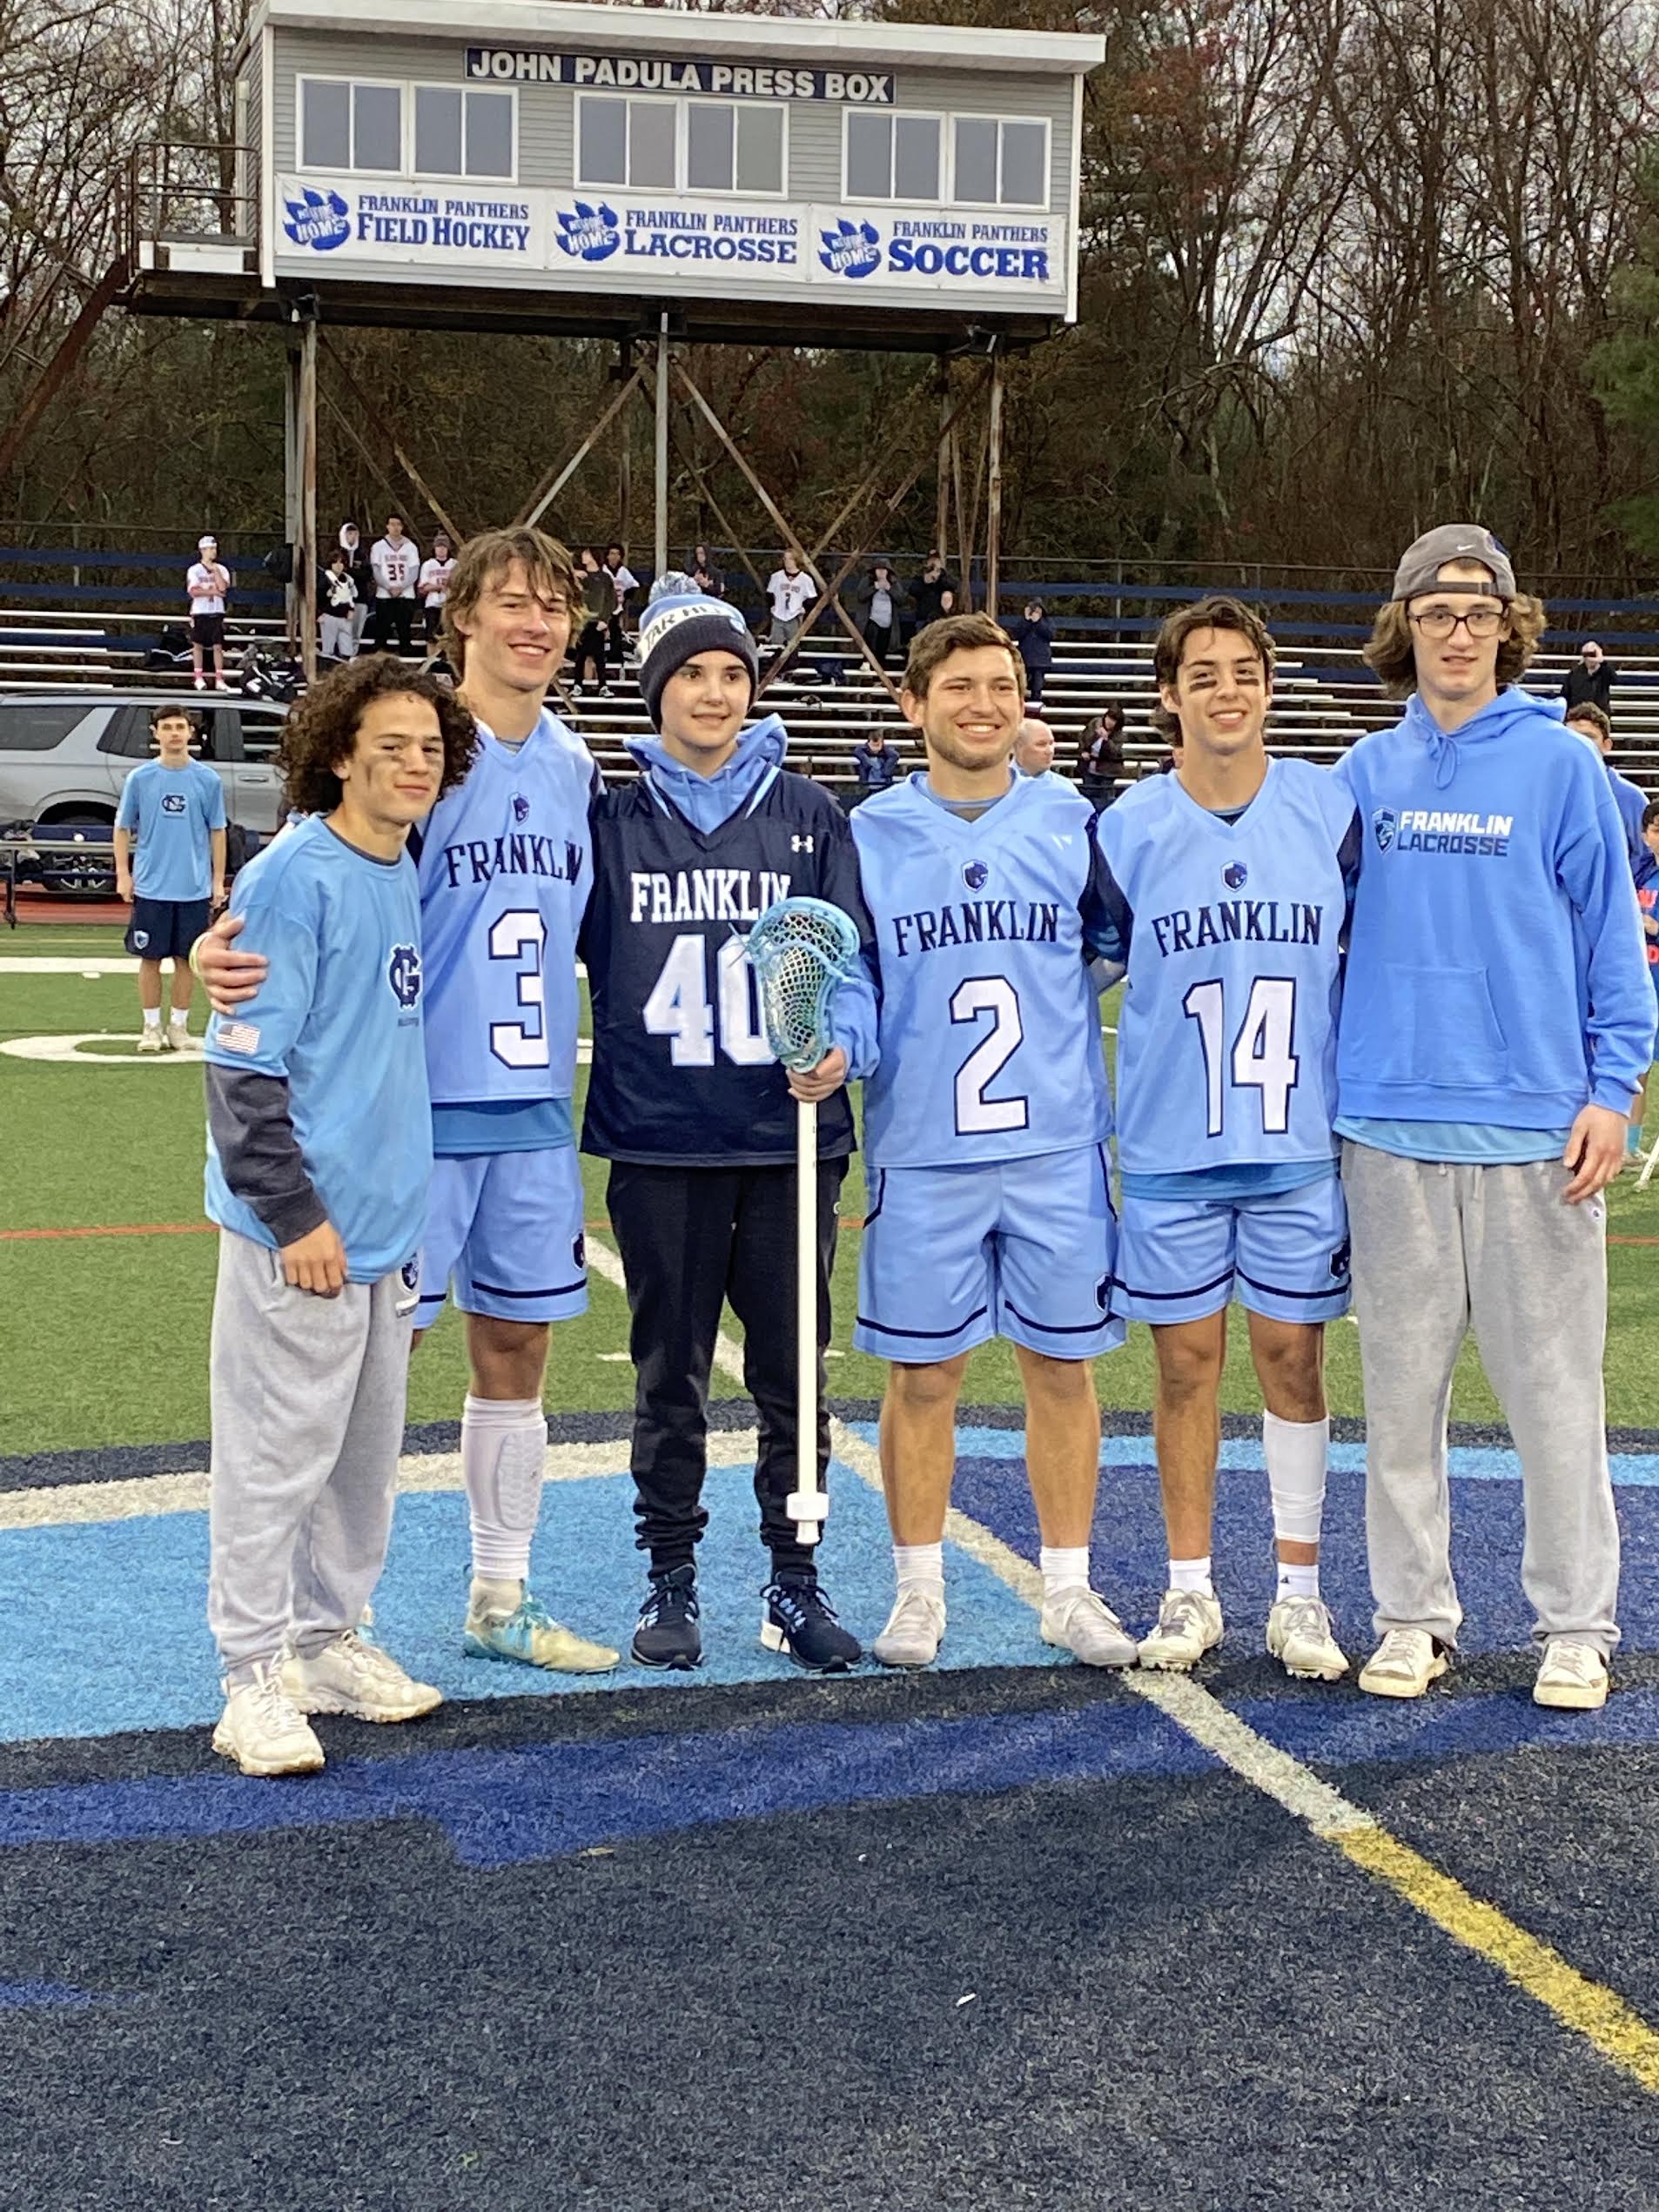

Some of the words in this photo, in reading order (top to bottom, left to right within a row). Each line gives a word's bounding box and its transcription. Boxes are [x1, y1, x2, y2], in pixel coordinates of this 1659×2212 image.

[471, 50, 561, 83] JOHN
[574, 57, 702, 90] PADULA
[711, 64, 815, 99] PRESS
[824, 72, 890, 103] BOX
[358, 195, 438, 215] FRANKLIN
[445, 199, 528, 220] PANTHERS
[626, 210, 707, 231] FRANKLIN
[713, 214, 798, 235] PANTHERS
[357, 212, 428, 245] FIELD
[433, 217, 530, 251] HOCKEY
[624, 229, 797, 264] LACROSSE
[893, 220, 966, 240] FRANKLIN
[972, 224, 1048, 243] PANTHERS
[888, 238, 1050, 280] SOCCER
[1400, 810, 1514, 836] FRANKLIN
[1396, 833, 1510, 857] LACROSSE
[891, 900, 1060, 957] FRANKLIN
[1151, 900, 1324, 958] FRANKLIN
[487, 908, 551, 1070] 3
[949, 975, 1030, 1136] 2
[1181, 975, 1300, 1138] 14
